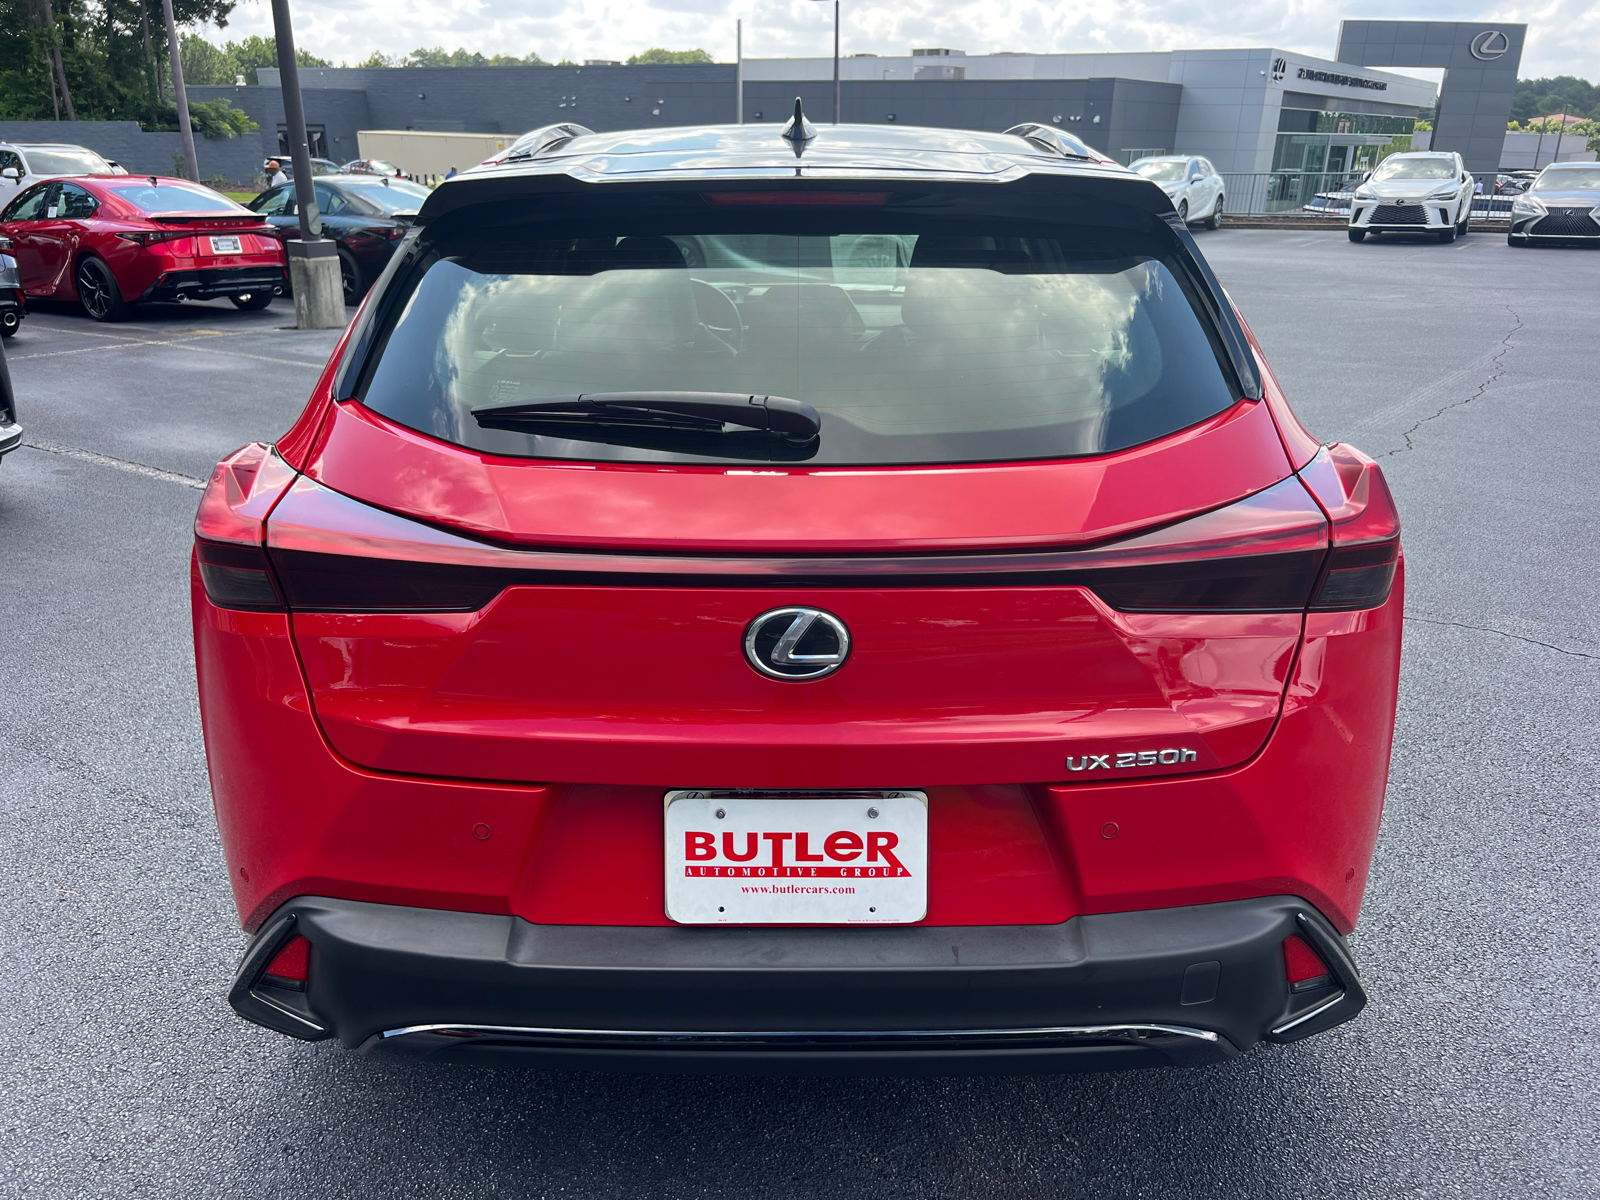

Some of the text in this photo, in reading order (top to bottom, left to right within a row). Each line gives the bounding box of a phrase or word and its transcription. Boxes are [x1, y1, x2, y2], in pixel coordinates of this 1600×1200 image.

[1066, 747, 1197, 771] UX 250h
[686, 867, 904, 877] AUTOMOTIVE GROUP
[741, 884, 855, 894] www.butlercars.com
